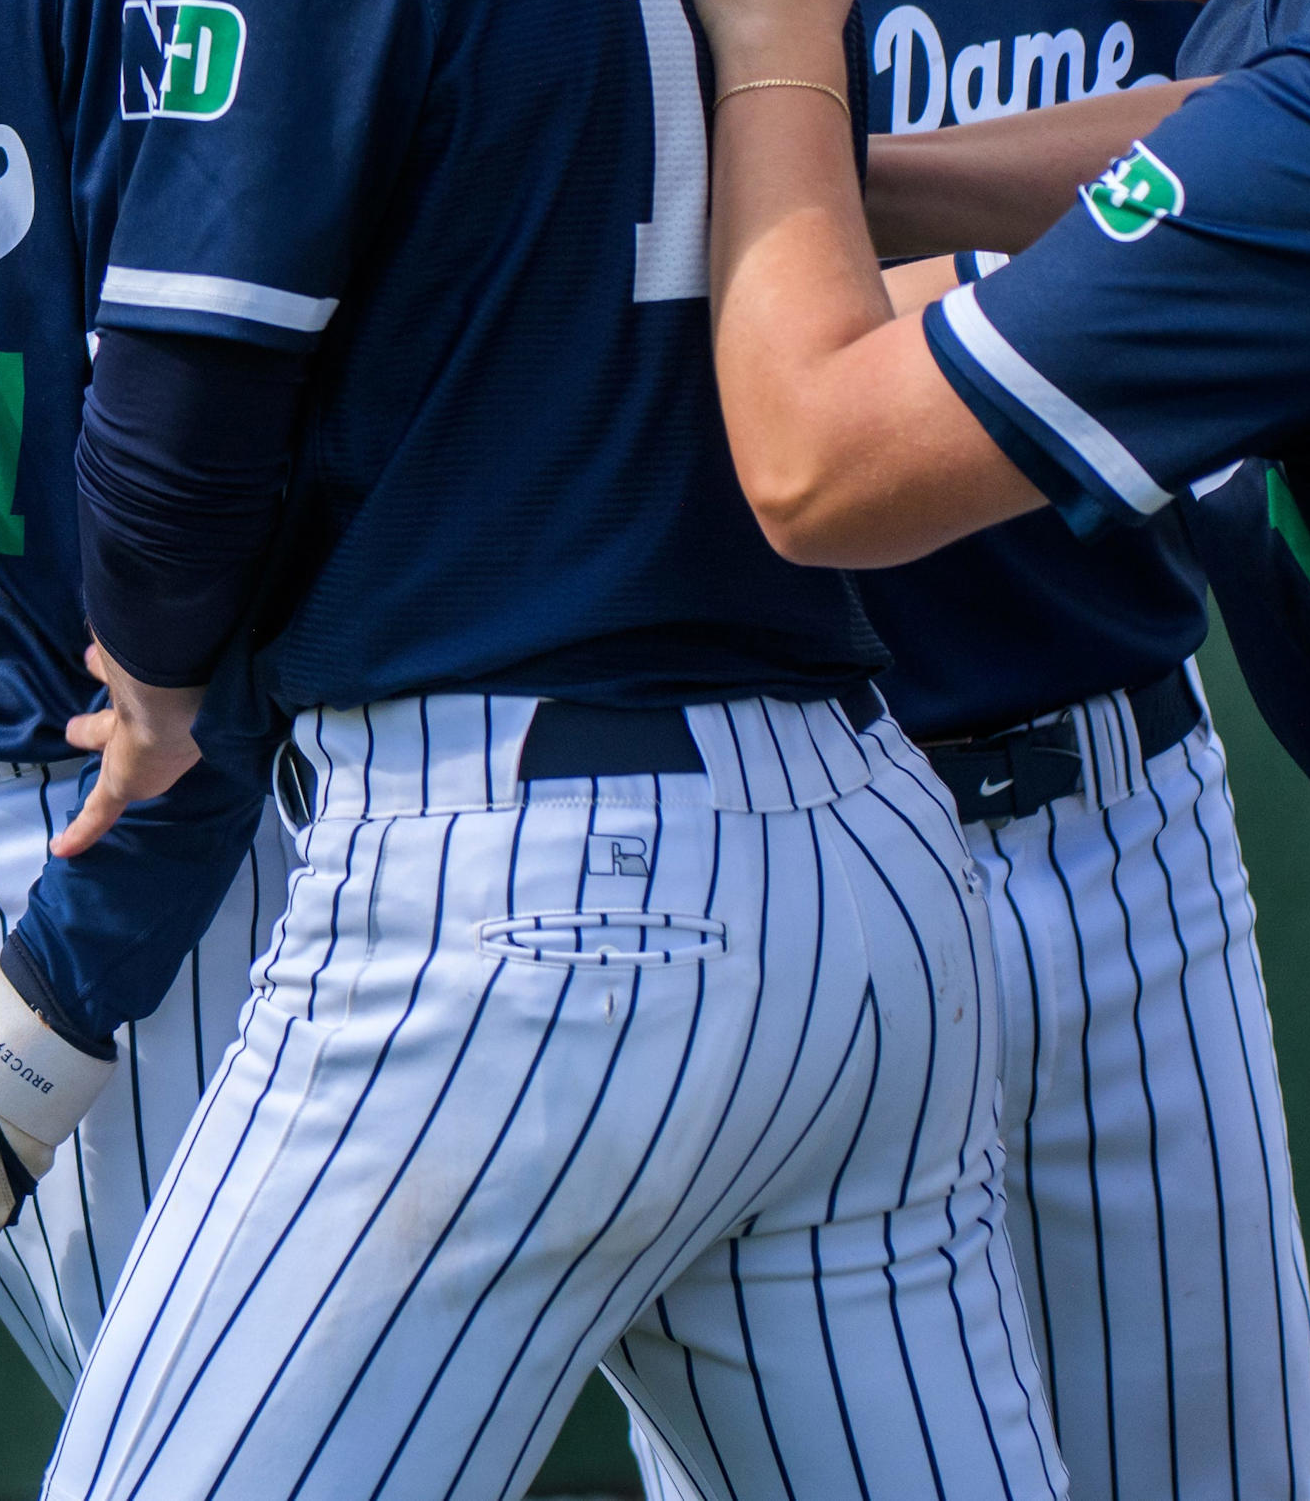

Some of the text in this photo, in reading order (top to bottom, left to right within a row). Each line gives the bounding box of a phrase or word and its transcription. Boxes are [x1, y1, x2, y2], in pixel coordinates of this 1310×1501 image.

[120, 0, 247, 121] ND
[873, 4, 1138, 135] Dame
[0, 1049, 54, 1095] BRUCE
